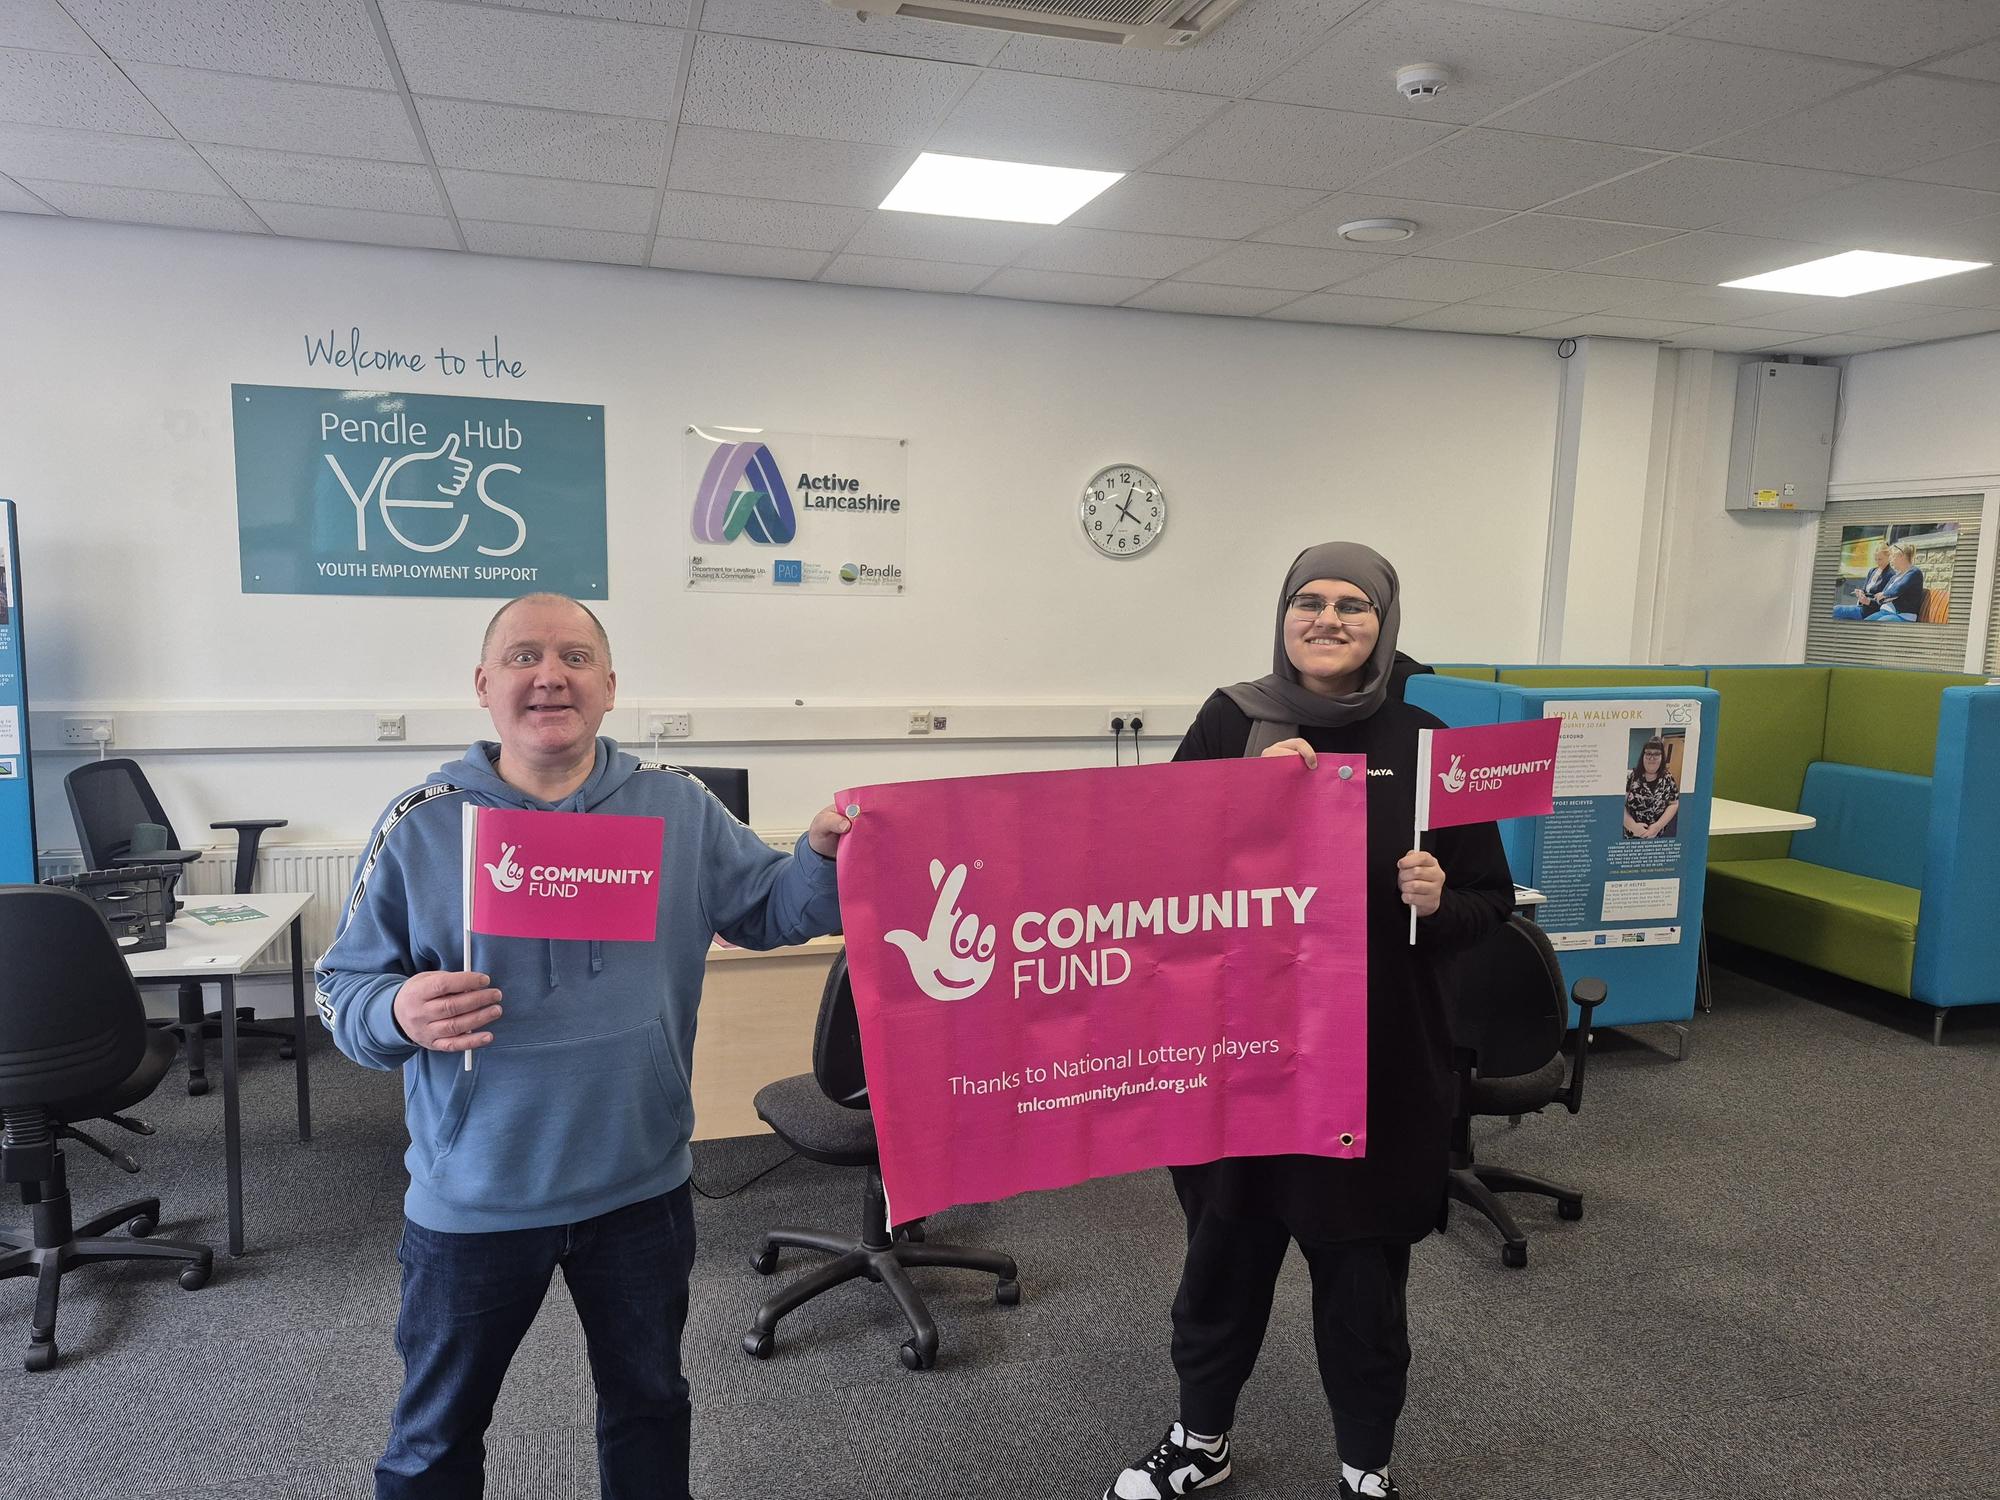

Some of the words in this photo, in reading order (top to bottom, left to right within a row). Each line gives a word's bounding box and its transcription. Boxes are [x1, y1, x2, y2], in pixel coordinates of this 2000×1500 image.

[304, 327, 426, 376] Welcome
[435, 347, 466, 376] to
[476, 335, 527, 378] the
[321, 412, 427, 445] Pendle
[464, 419, 523, 450] Hub
[797, 473, 860, 491] Active
[1106, 478, 1115, 488] 11
[1120, 473, 1130, 484] 12
[804, 492, 901, 511] Lancashire
[1094, 490, 1105, 501] 10
[1146, 492, 1153, 502] 2
[1088, 505, 1096, 515] 9
[1151, 507, 1158, 517] 3
[1094, 520, 1102, 530] 8
[1144, 522, 1152, 532] 4
[1106, 534, 1113, 544] 7
[1118, 538, 1125, 548] 6
[1133, 535, 1140, 545] 5
[317, 562, 367, 577] YOUTH
[371, 563, 470, 580] EMPLOYMENT
[474, 566, 538, 581] SUPPORT
[778, 564, 798, 579] PAC
[860, 564, 902, 577] Pendle
[1583, 710, 1643, 720] WALLWORK
[639, 762, 661, 770] NIKE
[1367, 768, 1394, 777] HAYA
[1469, 759, 1552, 780] COMMUNITY
[425, 784, 450, 799] NIKE
[1468, 778, 1502, 793] FUND
[381, 809, 399, 836] NIKE
[530, 865, 654, 885] COMMUNITY
[528, 882, 578, 898] FUND
[1011, 886, 1319, 953] COMMUNITY
[1013, 947, 1132, 1000] FUND
[948, 1071, 1020, 1095] Thanks
[1025, 1065, 1047, 1084] to
[1053, 1049, 1132, 1080] National
[1138, 1044, 1207, 1066] Lottery
[1212, 1036, 1280, 1063] players
[1017, 1073, 1208, 1114] tnlcommunityfund.org.uk
